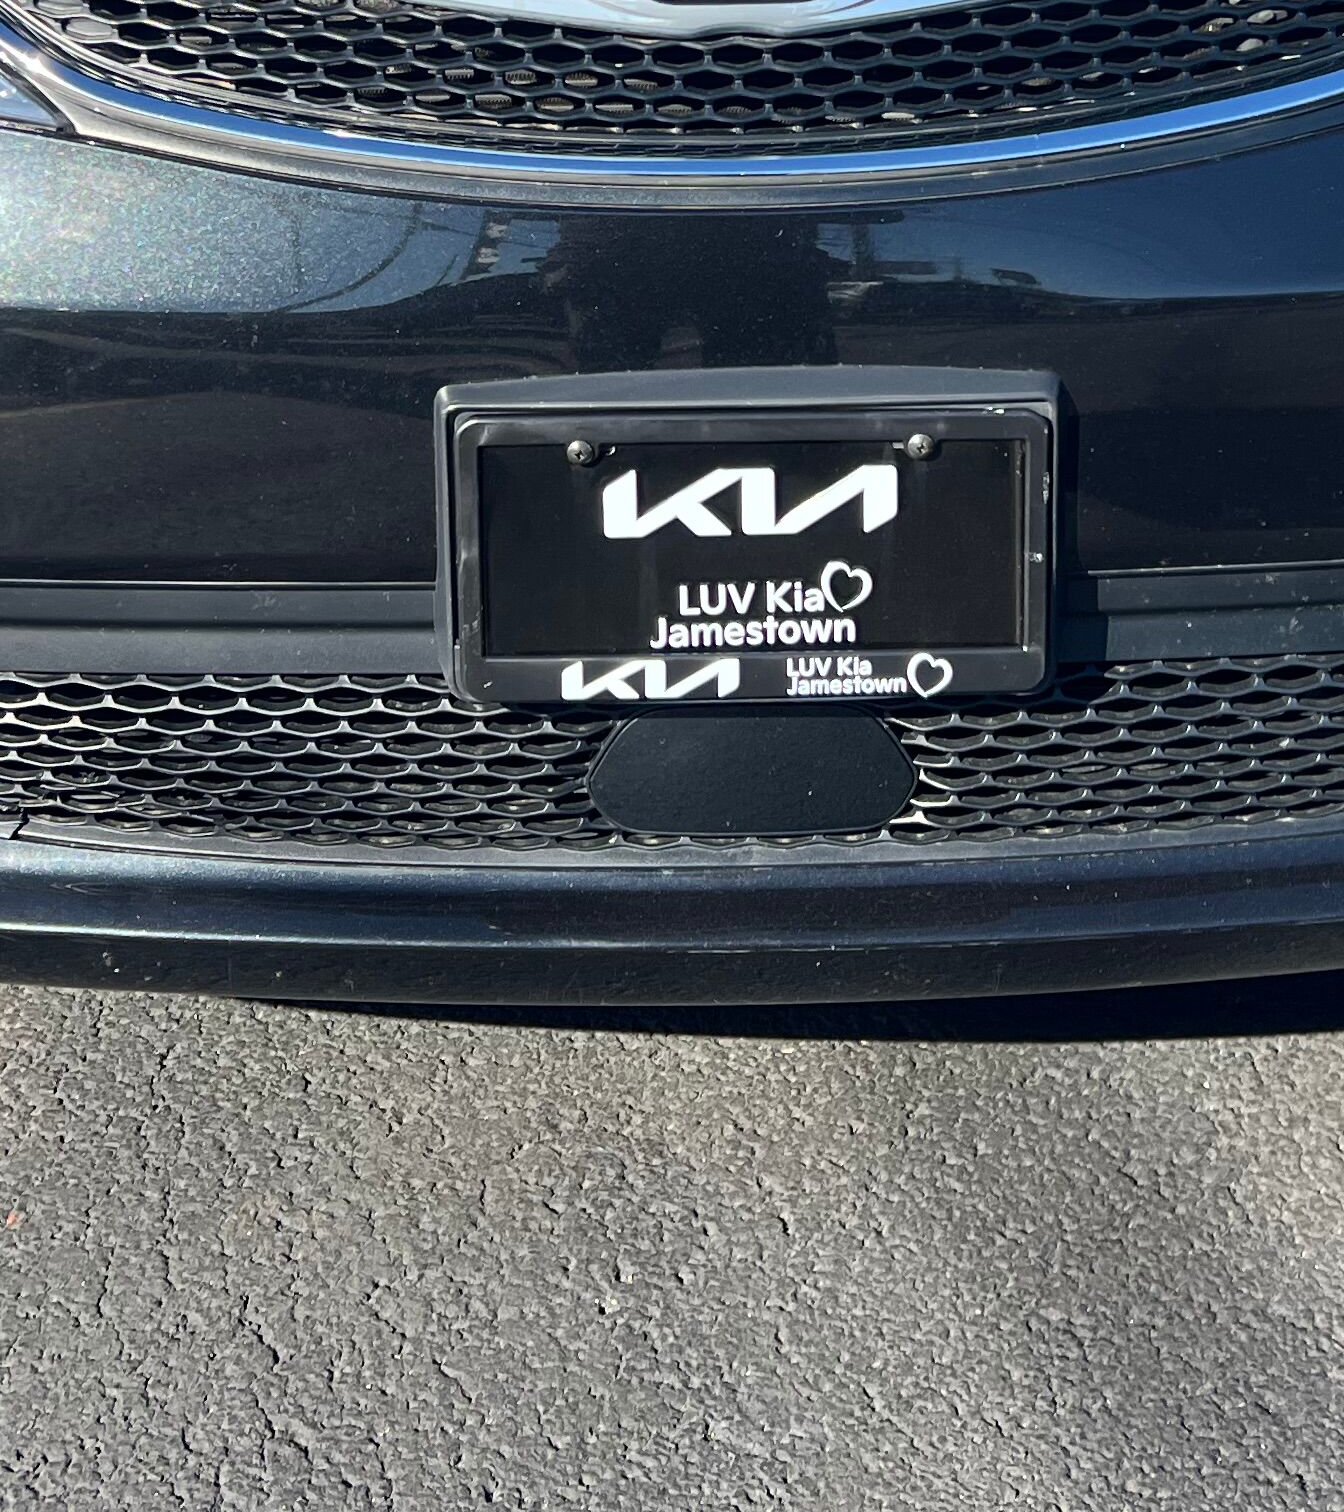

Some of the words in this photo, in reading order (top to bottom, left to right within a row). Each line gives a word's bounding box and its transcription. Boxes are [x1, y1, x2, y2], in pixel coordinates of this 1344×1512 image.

[602, 464, 898, 539] KIA
[678, 581, 755, 617] LUV
[766, 580, 826, 614] Kia
[650, 615, 856, 650] Jamestown
[561, 657, 741, 700] KIA
[786, 656, 832, 678] LUV
[836, 656, 873, 676] Kia
[786, 674, 908, 697] Jamestown
